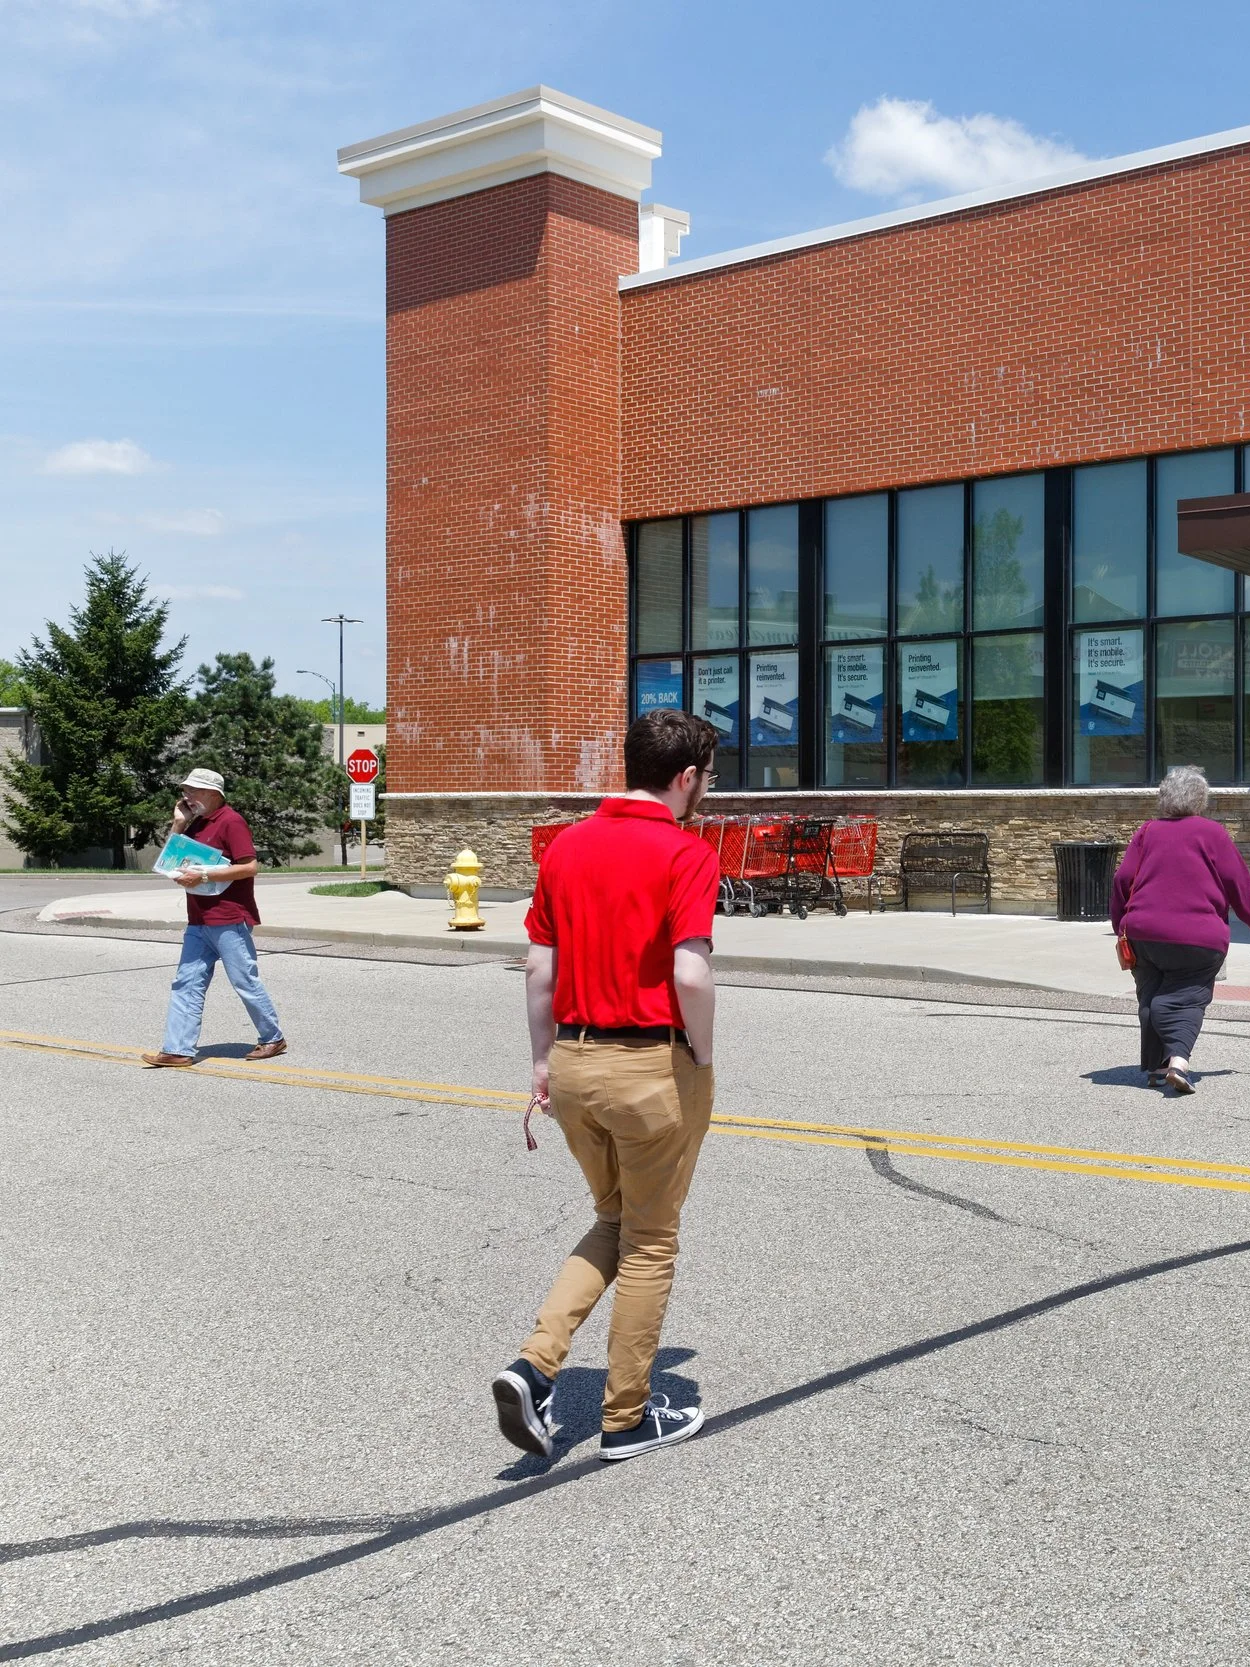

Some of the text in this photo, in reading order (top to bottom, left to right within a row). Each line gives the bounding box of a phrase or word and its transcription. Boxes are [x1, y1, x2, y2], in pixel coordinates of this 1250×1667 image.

[1088, 636, 1123, 647] It's smart.
[1088, 647, 1125, 657] It's mobile.
[838, 654, 866, 663] It's smart.
[908, 654, 932, 664] Printing
[838, 663, 868, 672] It's mobile.
[908, 662, 942, 672] reinvented.
[1088, 659, 1126, 668] It's secure.
[698, 666, 733, 676] Don't just call
[756, 664, 778, 673] Printing
[756, 672, 786, 681] reinvented.
[838, 673, 868, 682] It's secure.
[698, 677, 702, 685] it
[707, 677, 726, 686] printer.
[641, 691, 678, 704] 20% BACK
[348, 759, 377, 773] STOP
